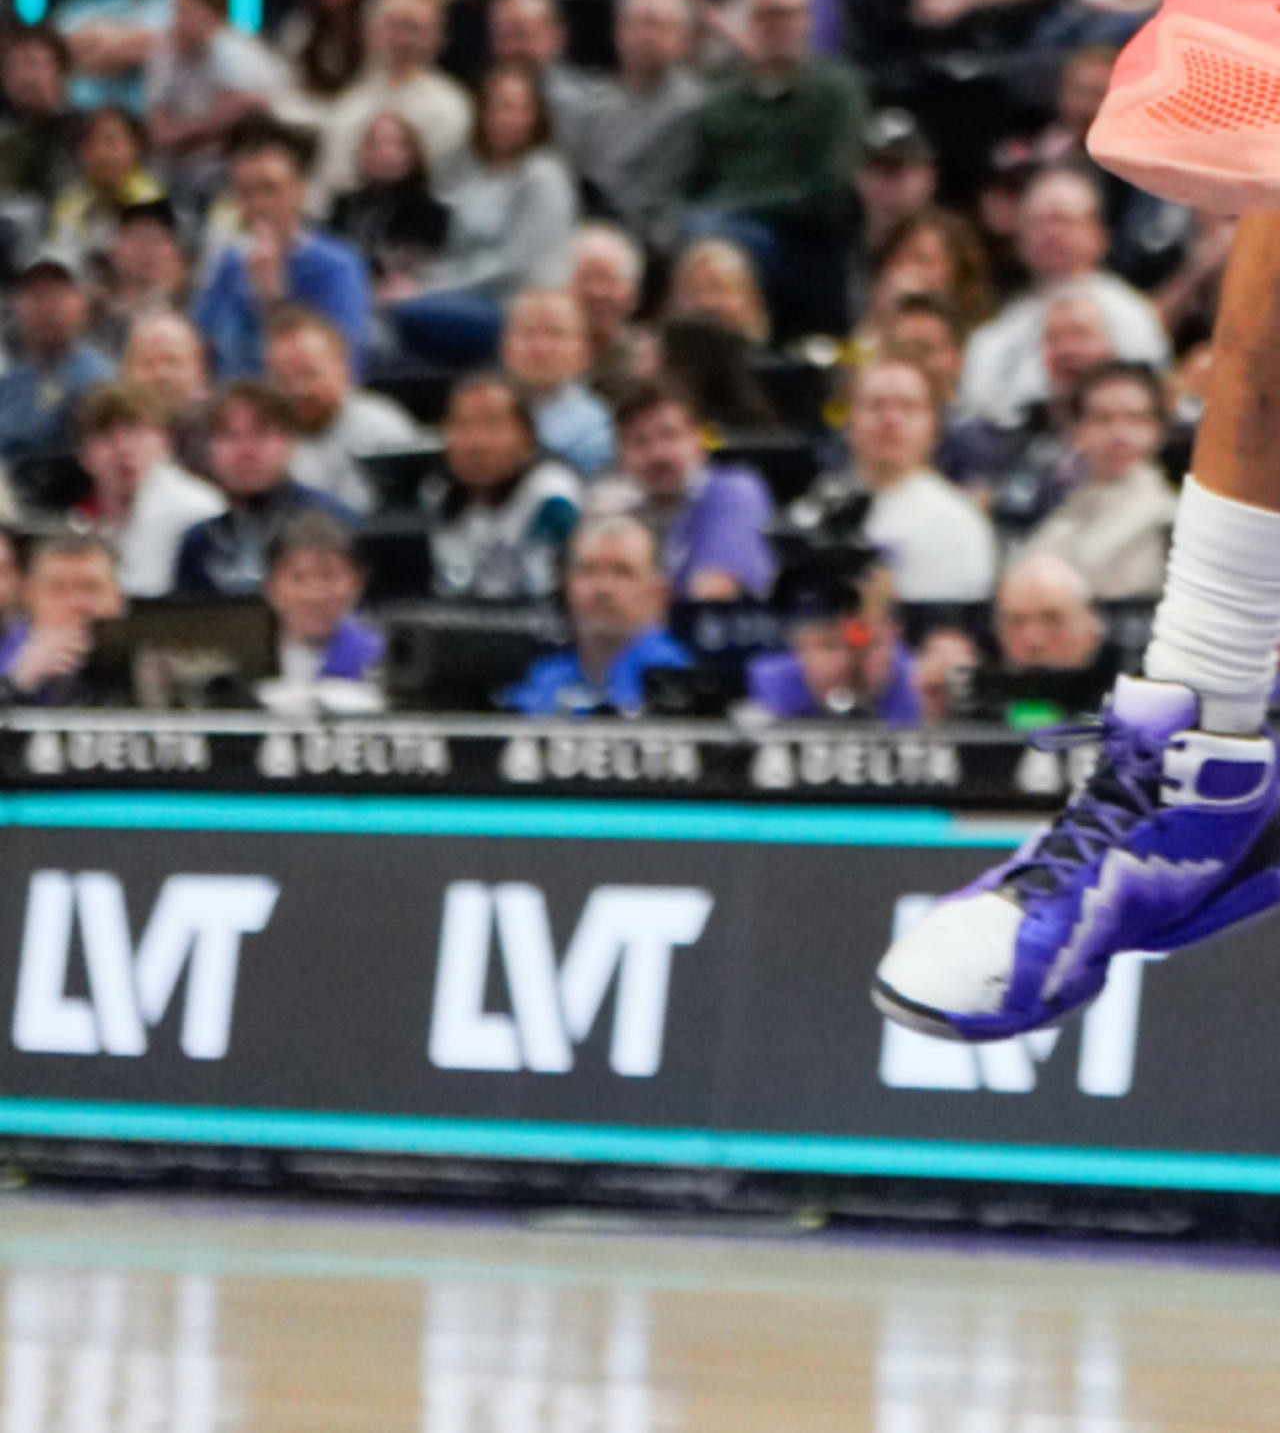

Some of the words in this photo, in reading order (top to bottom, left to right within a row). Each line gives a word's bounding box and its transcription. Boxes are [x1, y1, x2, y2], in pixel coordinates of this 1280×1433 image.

[66, 731, 209, 772] DELTA
[302, 734, 450, 776] DELTA
[547, 738, 700, 784] DELTA
[802, 742, 960, 787] DELTA
[13, 870, 281, 1060] LVT
[428, 881, 714, 1078] LVT
